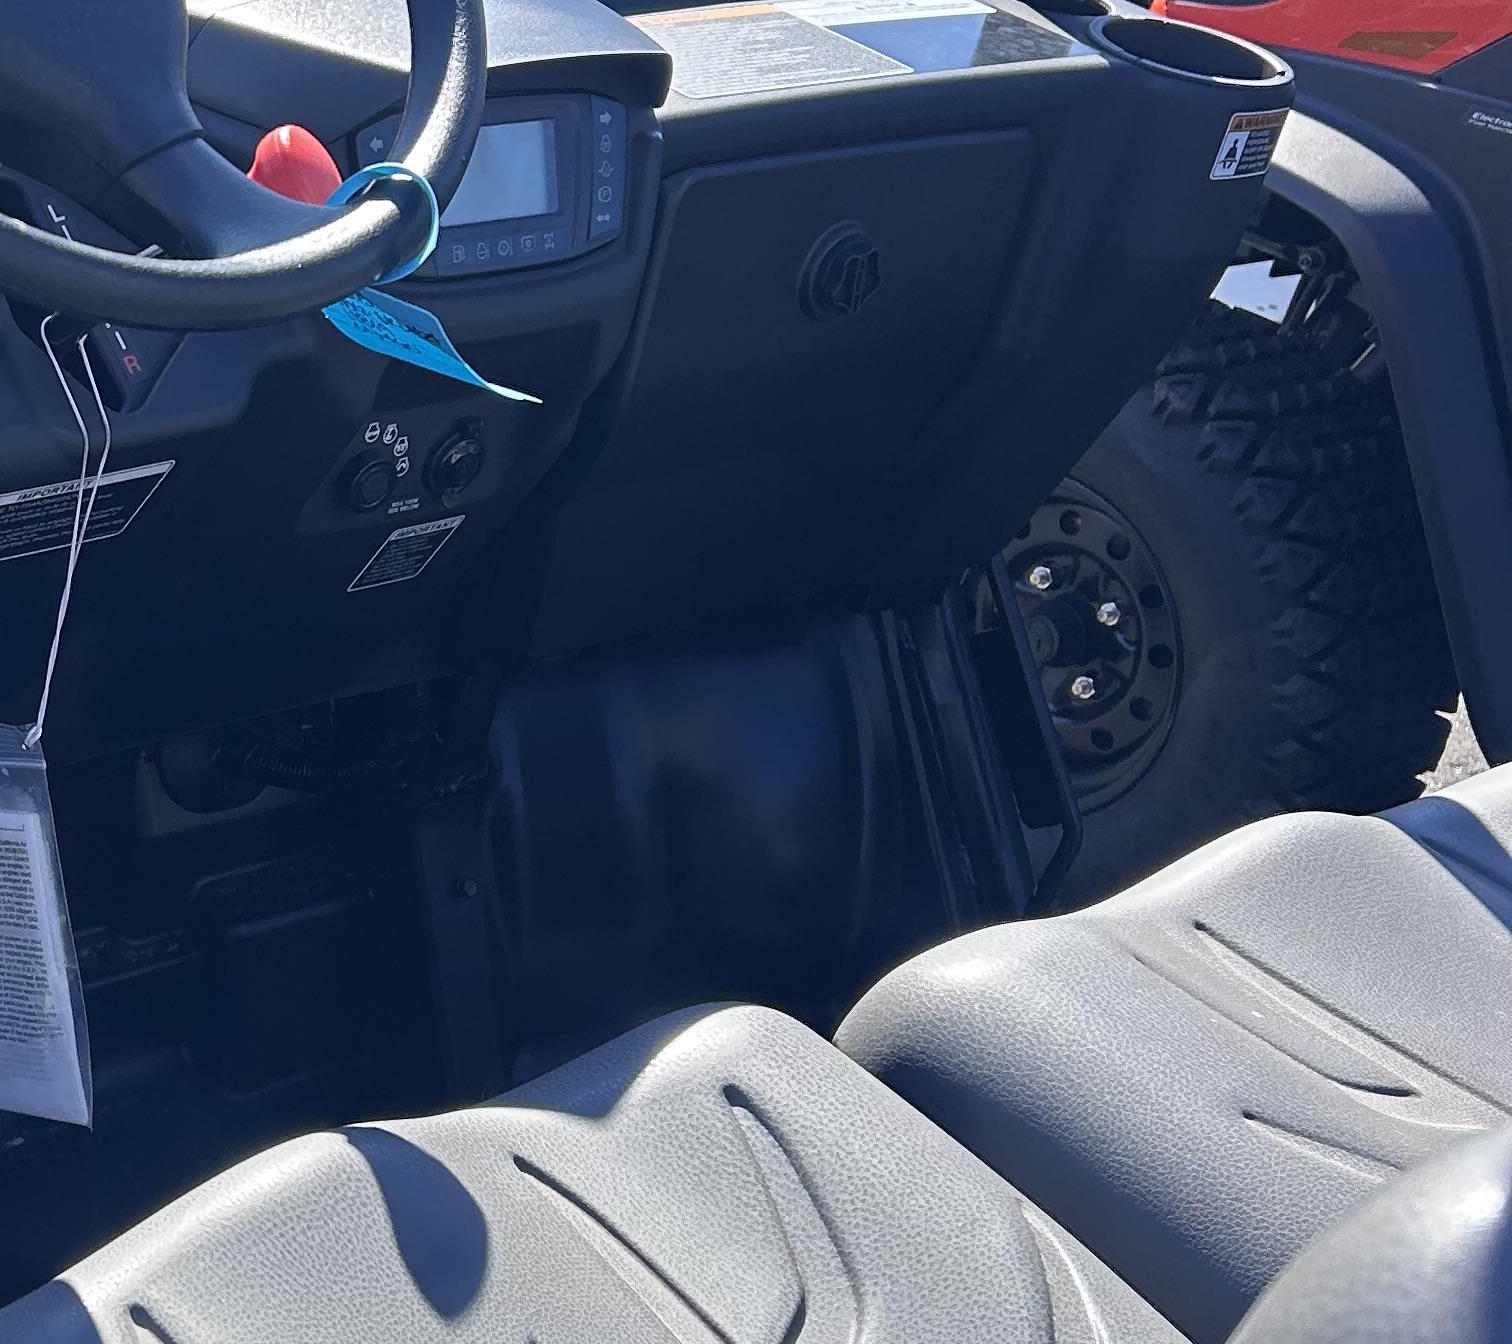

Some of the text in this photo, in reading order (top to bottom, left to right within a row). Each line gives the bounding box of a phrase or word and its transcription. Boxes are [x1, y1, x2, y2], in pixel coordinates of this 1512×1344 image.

[47, 204, 66, 223] L
[122, 354, 142, 375] R
[16, 479, 94, 501] IMPORTANT
